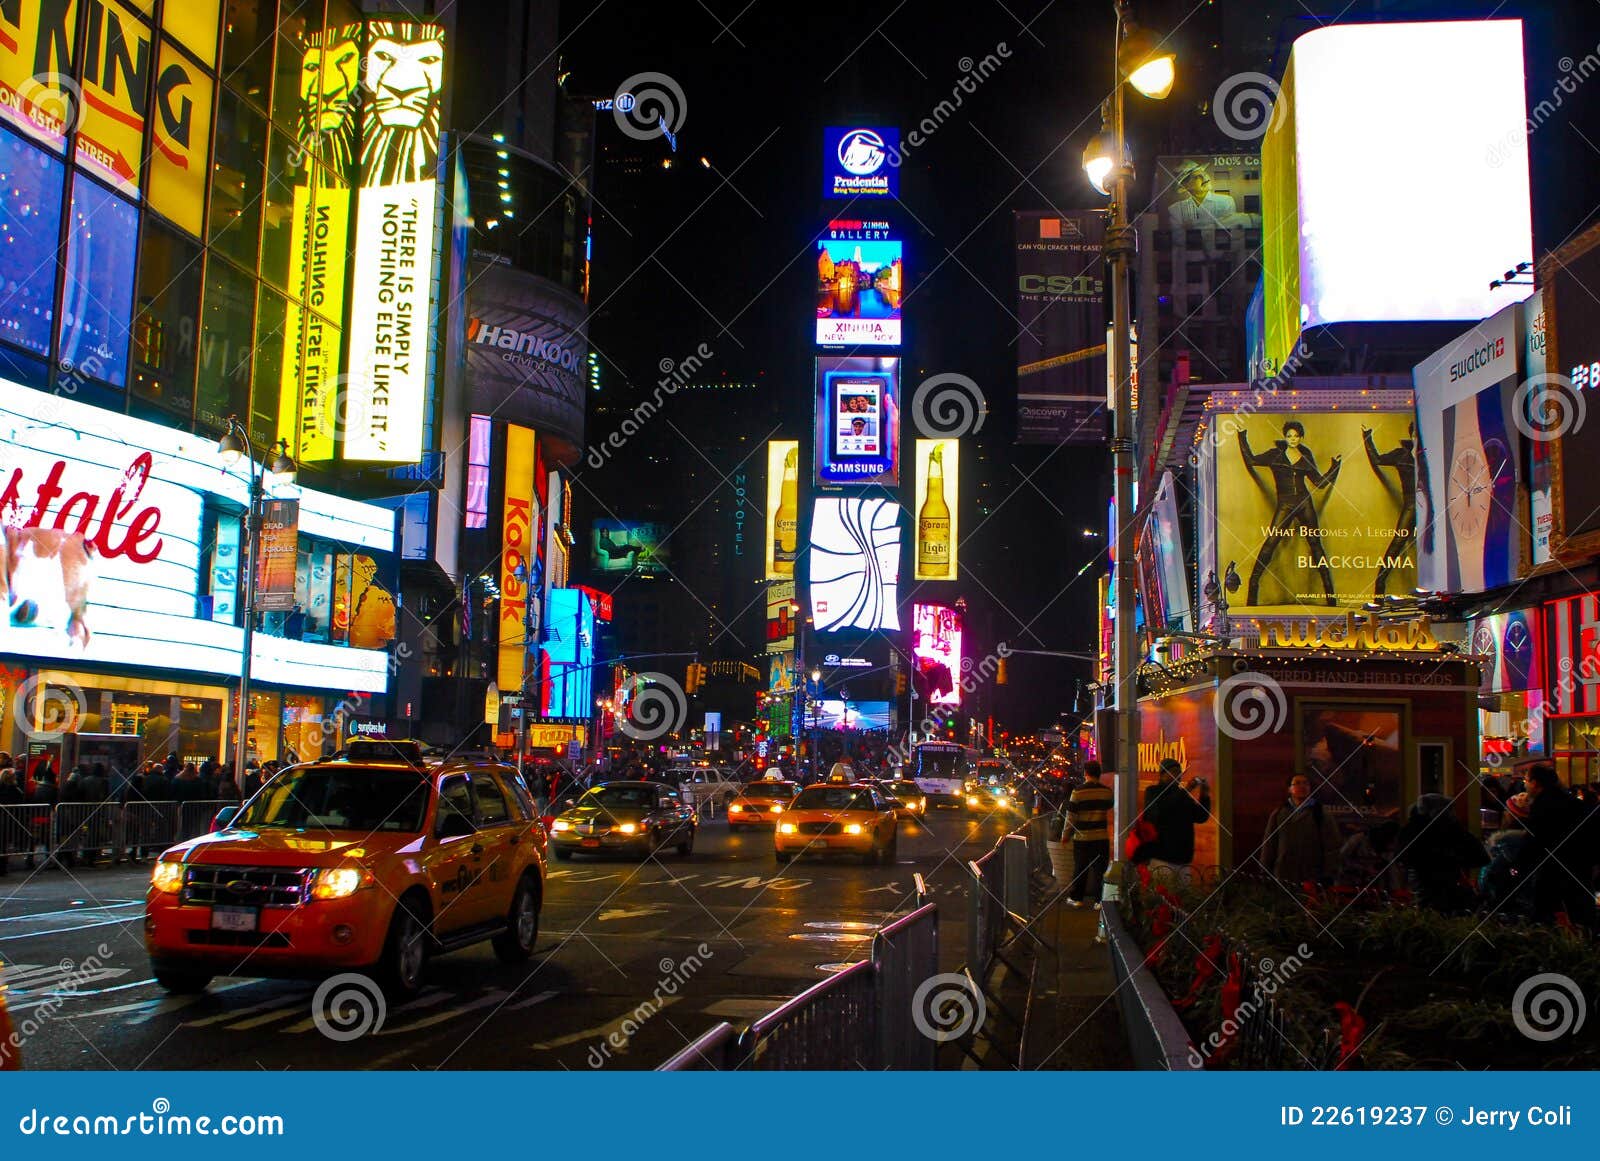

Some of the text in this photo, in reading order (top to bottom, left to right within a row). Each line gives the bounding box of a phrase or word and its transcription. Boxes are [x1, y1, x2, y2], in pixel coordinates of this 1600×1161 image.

[28, 106, 62, 138] 45TH
[77, 137, 115, 171] STREET
[1213, 156, 1241, 166] 100%
[833, 175, 889, 188] Prudential
[862, 221, 890, 230] XINHUA
[830, 230, 889, 240] GALLERY
[377, 203, 399, 305] NOTHING
[1047, 243, 1069, 251] CRACK
[398, 276, 413, 294] IS
[1018, 274, 1103, 295] CSI:
[1043, 295, 1103, 303] EXPERIENCE
[375, 312, 393, 356] ELSE
[394, 302, 413, 376] SIMPLY
[502, 352, 546, 371] driving
[1450, 339, 1496, 383] swatch
[372, 363, 391, 406] LIKE
[830, 463, 884, 474] SAMSUNG
[735, 474, 746, 556] NOVOTEL
[263, 522, 284, 530] DEAD
[1352, 526, 1362, 537] A
[263, 545, 294, 553] SCROLLS
[923, 541, 947, 555] Light
[1297, 555, 1414, 569] BLACKGLAMA
[1258, 611, 1441, 650] nuchas
[1404, 673, 1452, 686] FOODS
[357, 721, 386, 735] sunglass hut
